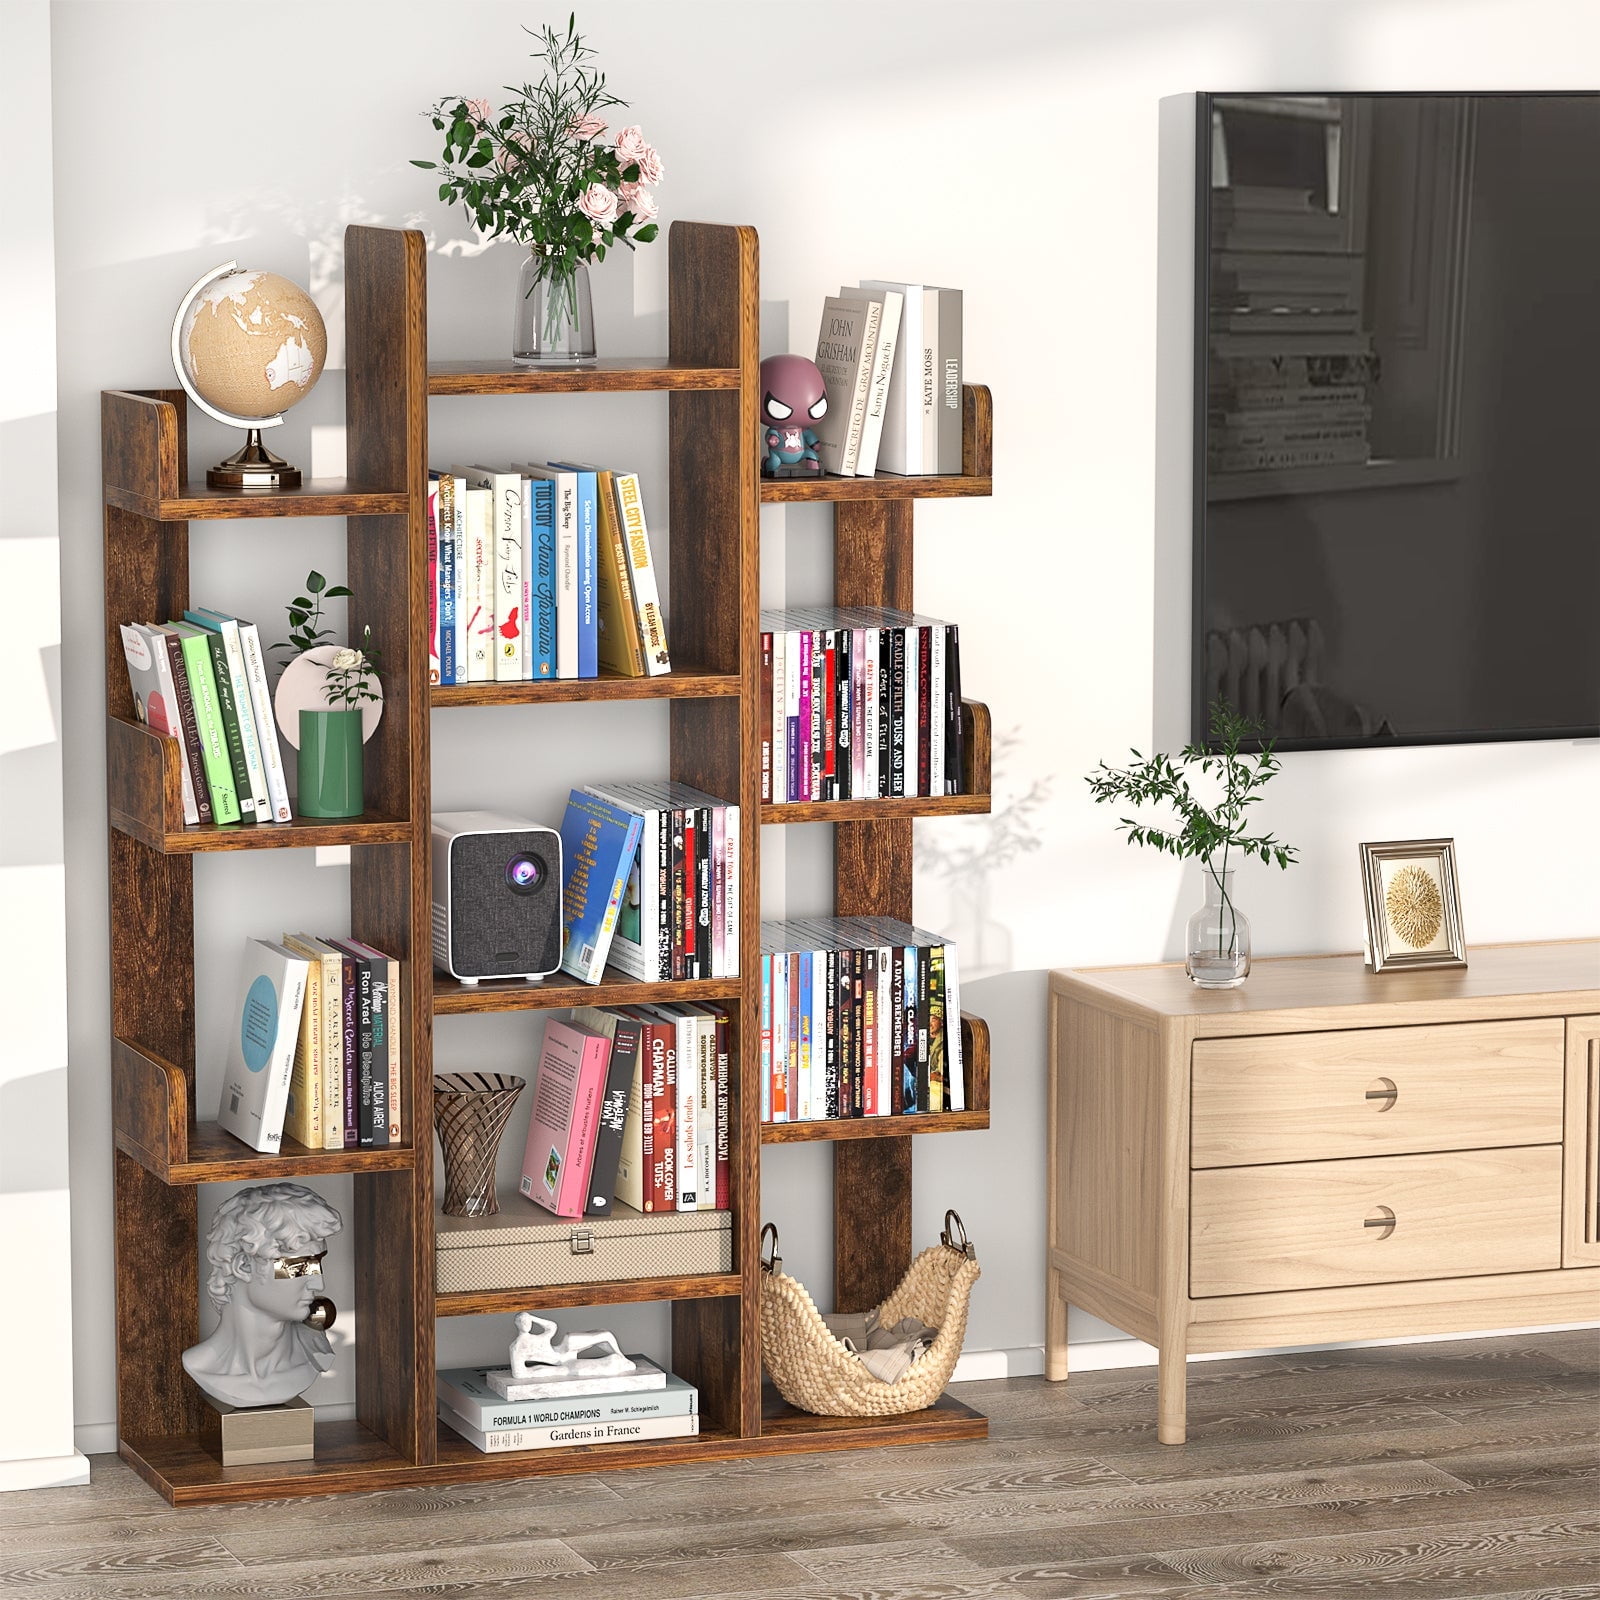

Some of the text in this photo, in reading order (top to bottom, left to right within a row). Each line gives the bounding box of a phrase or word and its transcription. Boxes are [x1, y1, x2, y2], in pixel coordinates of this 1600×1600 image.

[828, 318, 854, 338] JOHN
[858, 366, 870, 393] GRAY
[864, 306, 880, 364] MOUNTAIN
[818, 341, 856, 362] GRISHAM
[876, 341, 892, 386] Noguchi
[924, 348, 933, 406] KATE MOSS
[946, 358, 958, 410] LEADERSHIP
[562, 488, 572, 529] The Big Sleep
[584, 500, 592, 524] Science
[620, 478, 648, 569] STEEL CITY FASHION
[440, 484, 452, 621] Architects Know What Managers Don't
[533, 484, 554, 656] TOLSTOY Anna Karenina
[583, 586, 592, 604] Open
[644, 602, 660, 647] BY LEAH MOOSE
[173, 651, 201, 776] CRUMBLED OAK LEAF Patricia
[235, 674, 258, 770] THE TRUMPET OF THE SWAN
[894, 634, 903, 792] CRADLE OF FILTH AND HER
[230, 722, 247, 784] SARAH LANE
[330, 976, 336, 984] 6
[895, 990, 902, 1003] TO
[344, 998, 355, 1027] Secret
[372, 1014, 383, 1048] MATERIAL
[894, 1004, 902, 1057] REMEMBER
[345, 1028, 354, 1065] Garden
[361, 971, 372, 1106] Ron Arad No Discipline
[652, 1038, 665, 1097] CHAPMAN
[666, 1049, 676, 1085] CALLUM
[374, 1081, 384, 1106] ALICIA
[717, 1053, 729, 1161] ГАСТРОЛЬНЫЕ ХРОНИКИ
[374, 1106, 384, 1129] AIREY
[684, 1095, 694, 1169] Les sabots fendus
[575, 1146, 584, 1168] Arbres
[654, 1161, 664, 1188] TUTS+
[664, 1148, 673, 1201] BOOK COVER
[493, 1409, 601, 1426] FORMULA 1 WORLD CHAMPIONS
[550, 1424, 641, 1441] Gardens in France
